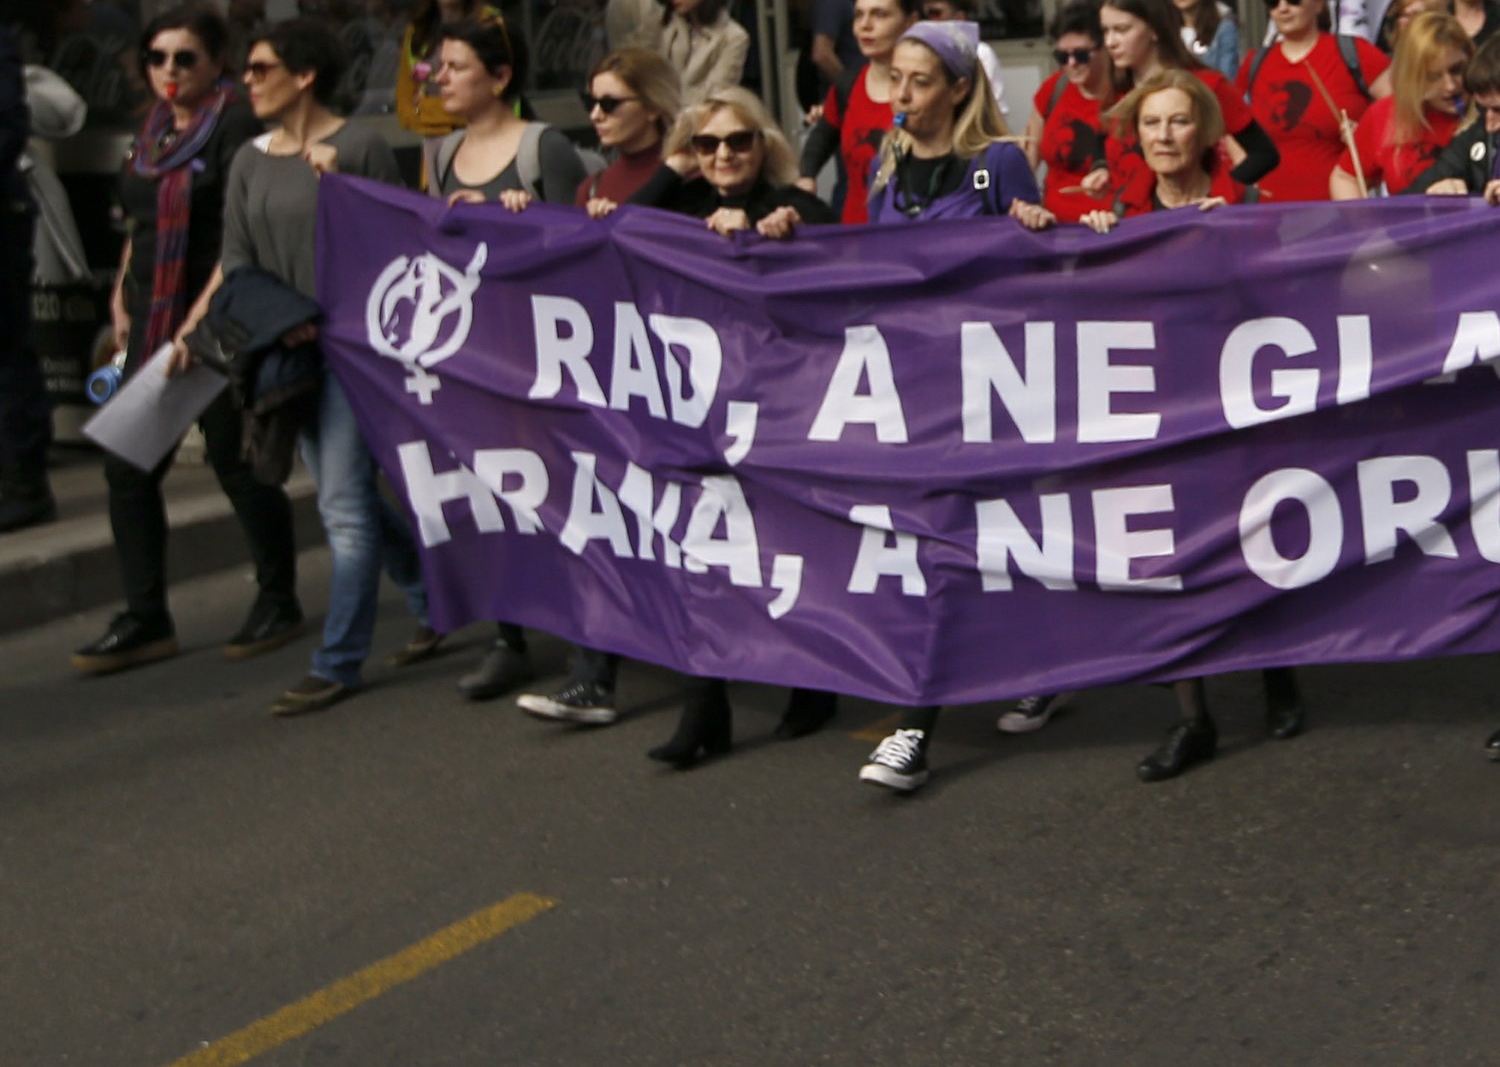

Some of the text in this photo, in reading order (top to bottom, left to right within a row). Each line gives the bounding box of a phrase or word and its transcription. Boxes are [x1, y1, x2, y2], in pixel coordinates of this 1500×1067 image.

[529, 294, 759, 465] RAD,
[807, 324, 909, 444] A
[960, 320, 1162, 444] NE
[847, 505, 927, 596] A
[976, 484, 1183, 593] NE
